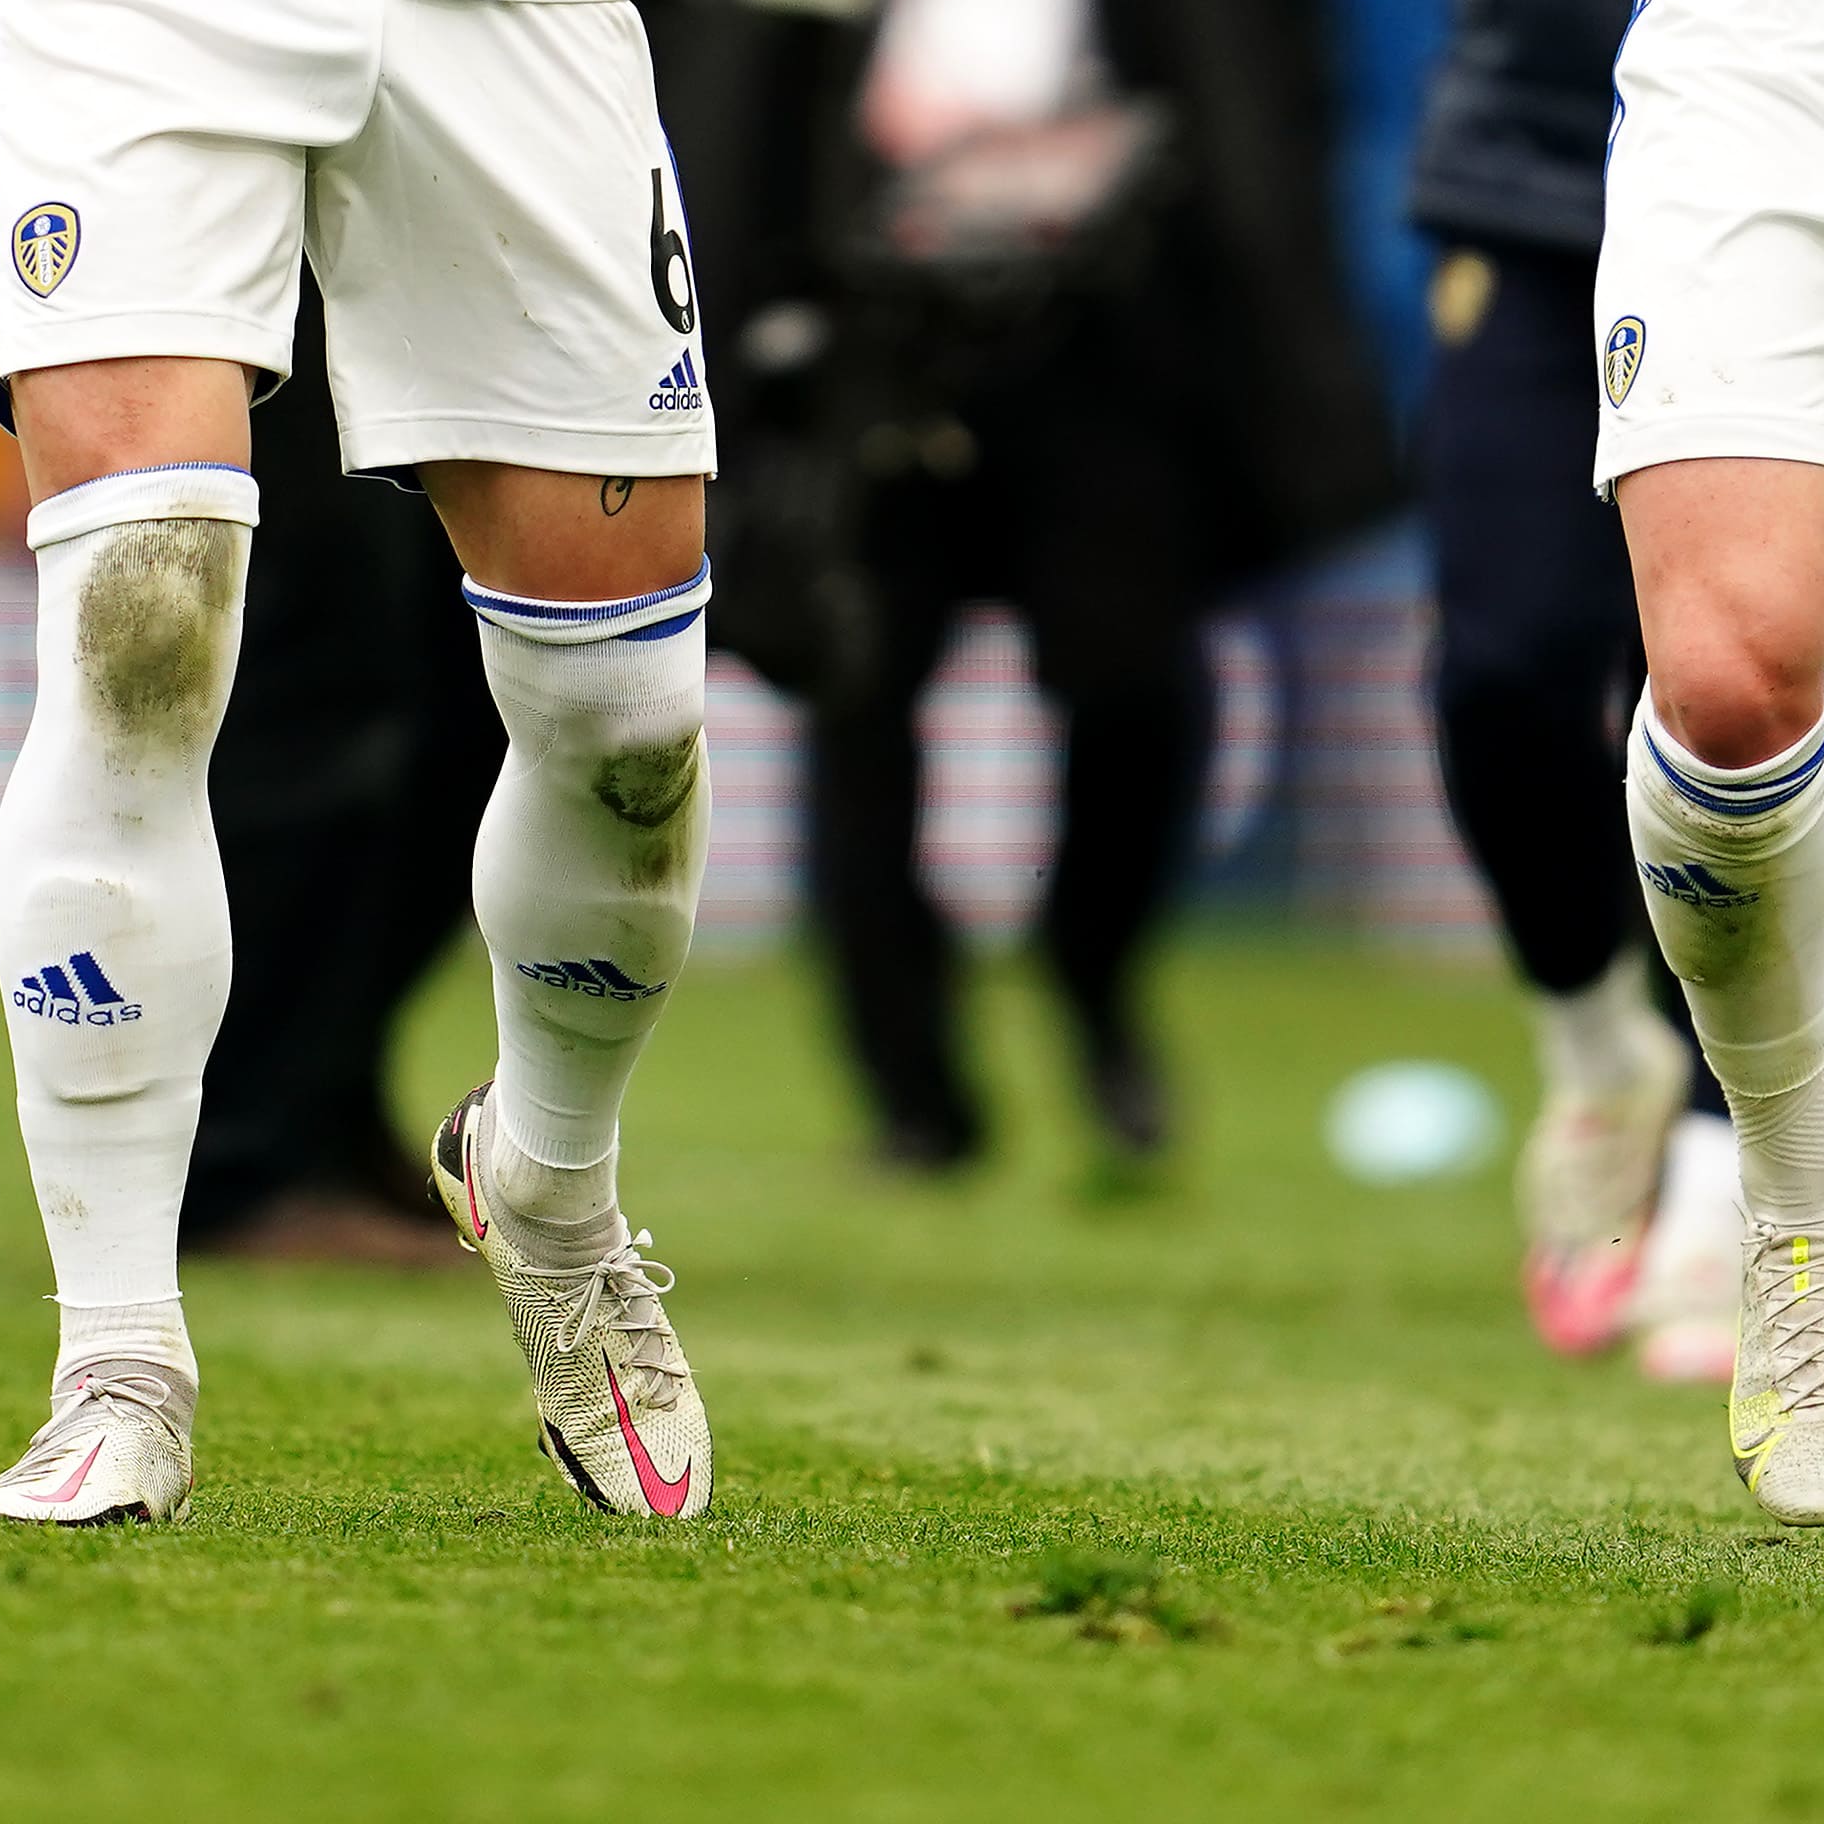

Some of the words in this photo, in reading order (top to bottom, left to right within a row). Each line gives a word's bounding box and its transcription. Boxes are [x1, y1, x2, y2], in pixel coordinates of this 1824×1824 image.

[650, 167, 695, 335] 6
[649, 387, 703, 411] adidas
[14, 989, 142, 1026] adidas
